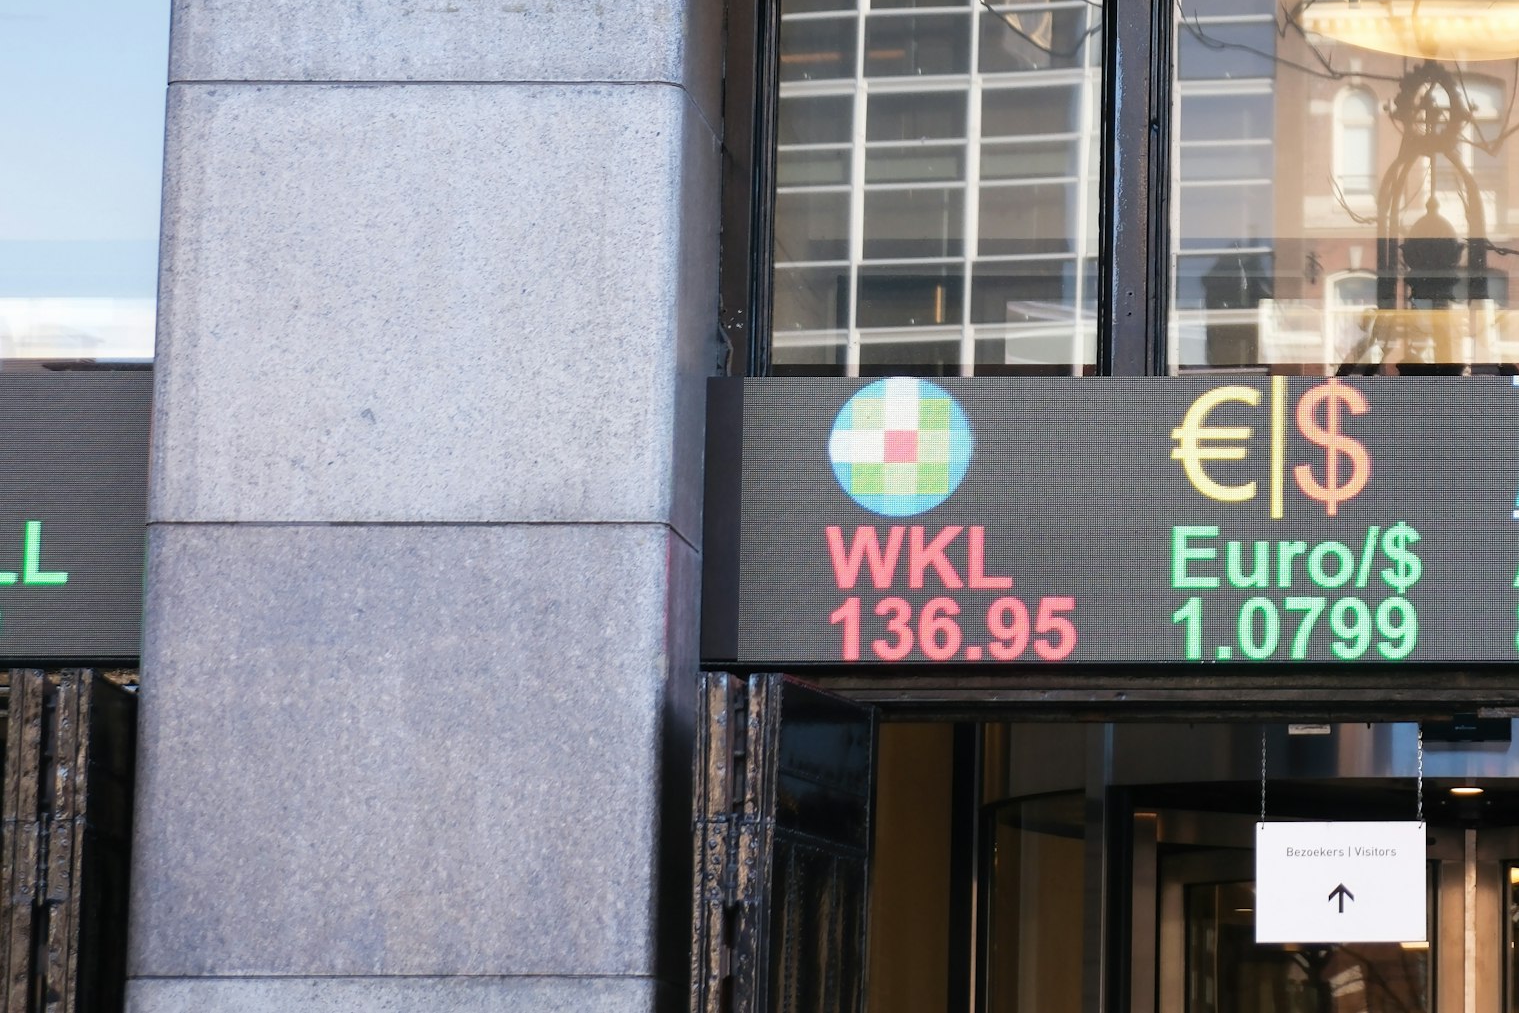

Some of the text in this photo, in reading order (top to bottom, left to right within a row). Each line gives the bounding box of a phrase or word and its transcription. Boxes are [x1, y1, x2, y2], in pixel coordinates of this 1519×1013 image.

[0, 519, 69, 585] L
[826, 525, 1014, 589] WKL
[1171, 521, 1423, 594] Euro/$
[828, 597, 1077, 660] 136.95
[1171, 597, 1420, 660] 1.0799
[1286, 847, 1345, 857] Bezoekers
[1355, 847, 1397, 857] Visitors
